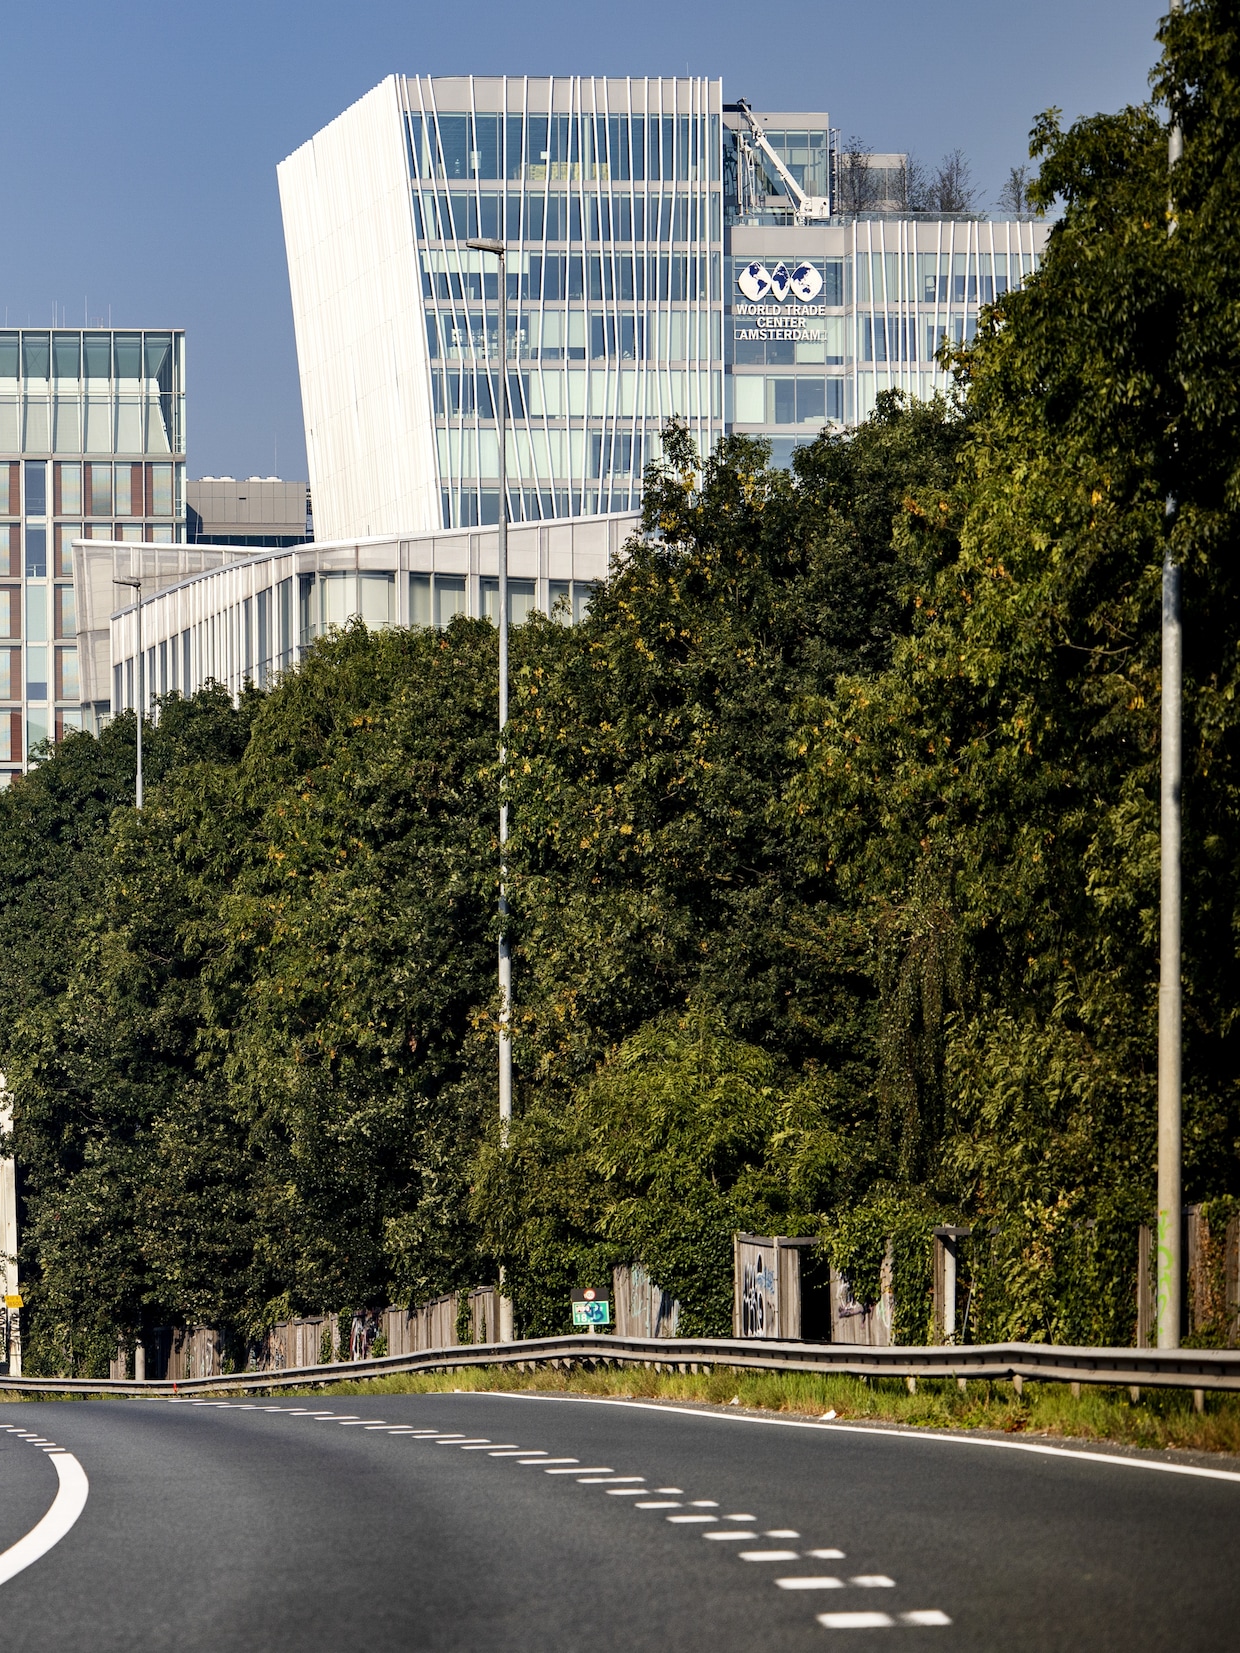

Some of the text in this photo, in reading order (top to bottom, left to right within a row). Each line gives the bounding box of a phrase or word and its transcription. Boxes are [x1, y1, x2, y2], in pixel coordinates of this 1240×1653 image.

[736, 304, 826, 315] WORLD TRADE
[756, 317, 806, 328] CENTER
[739, 329, 820, 340] AMSTERDAM
